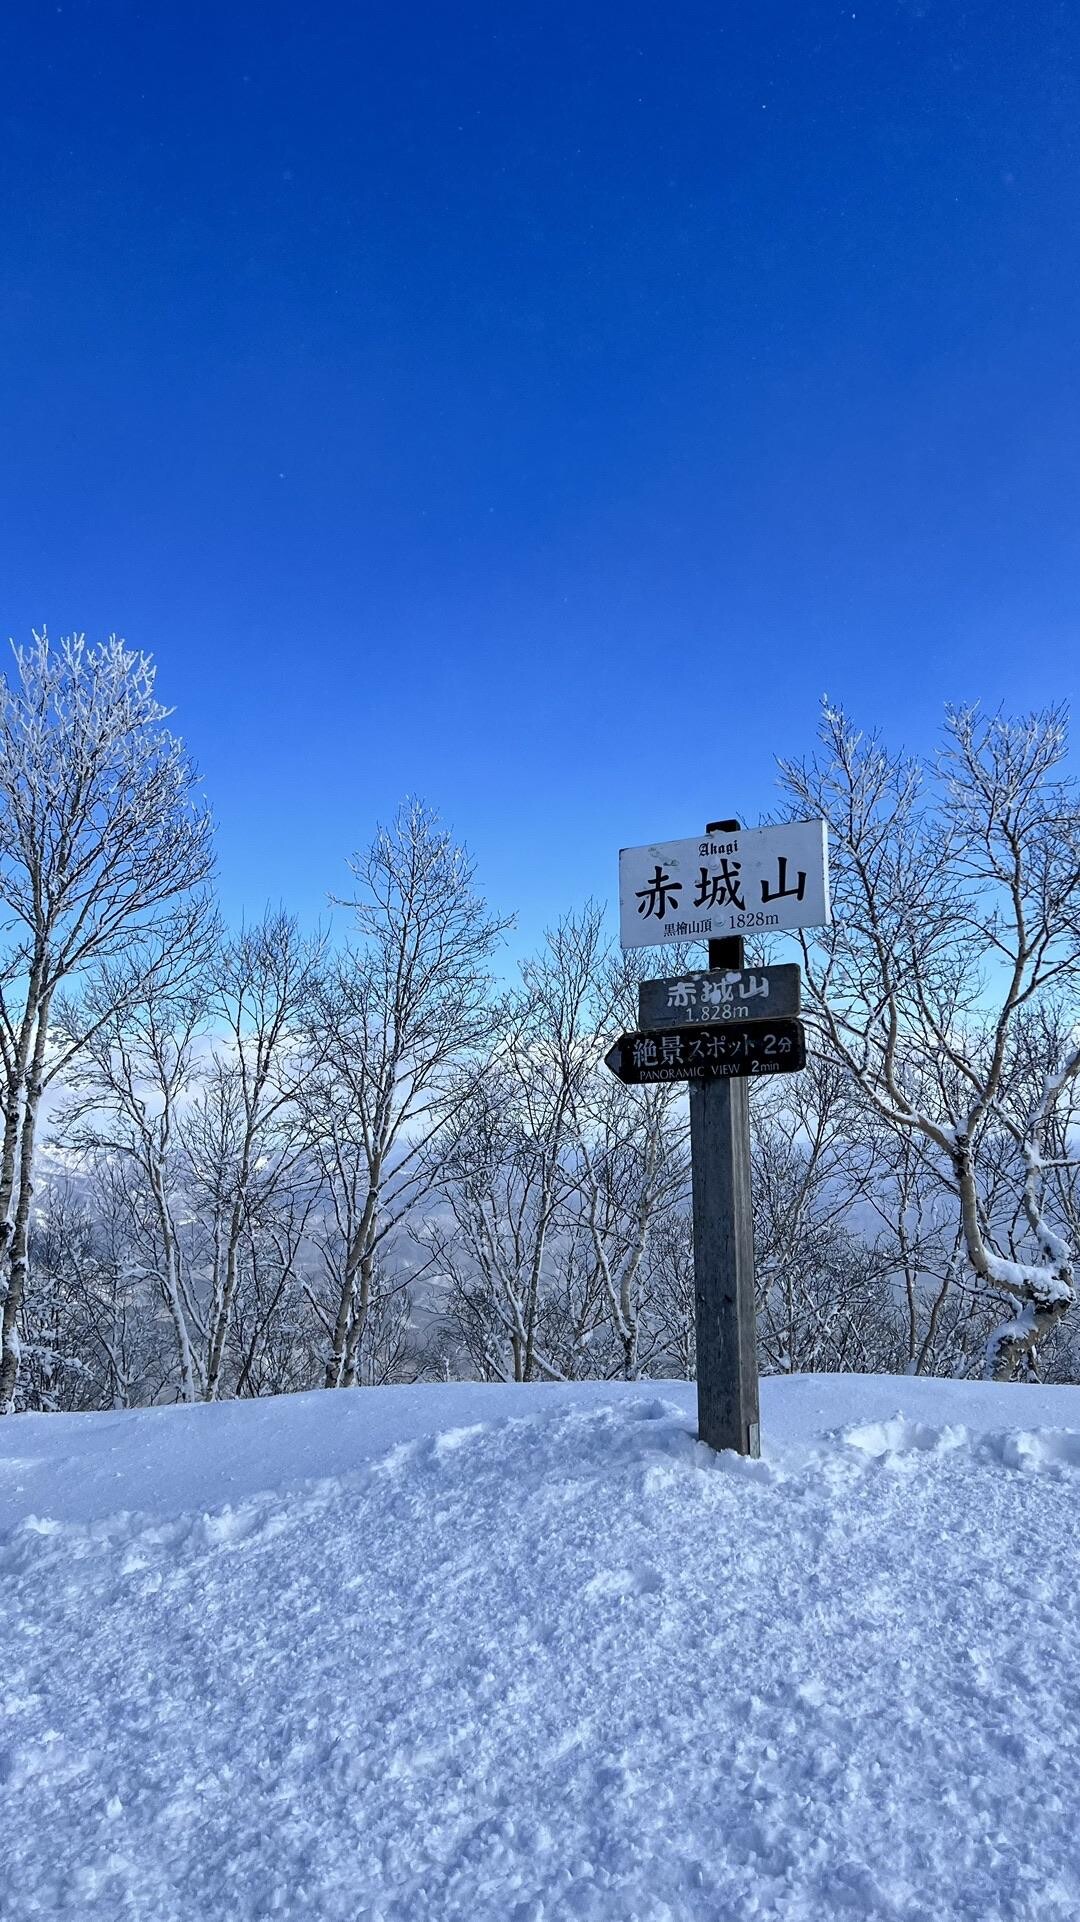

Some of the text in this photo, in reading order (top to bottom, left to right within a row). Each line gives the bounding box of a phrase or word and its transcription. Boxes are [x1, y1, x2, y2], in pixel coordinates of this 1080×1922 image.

[698, 840, 739, 857] Akagi
[635, 857, 807, 920] 赤城山
[729, 912, 779, 929] 1828m
[632, 1033, 792, 1068] 絶景スポット 2分
[639, 1066, 705, 1081] PANORAMIC
[711, 1064, 741, 1076] VIEW
